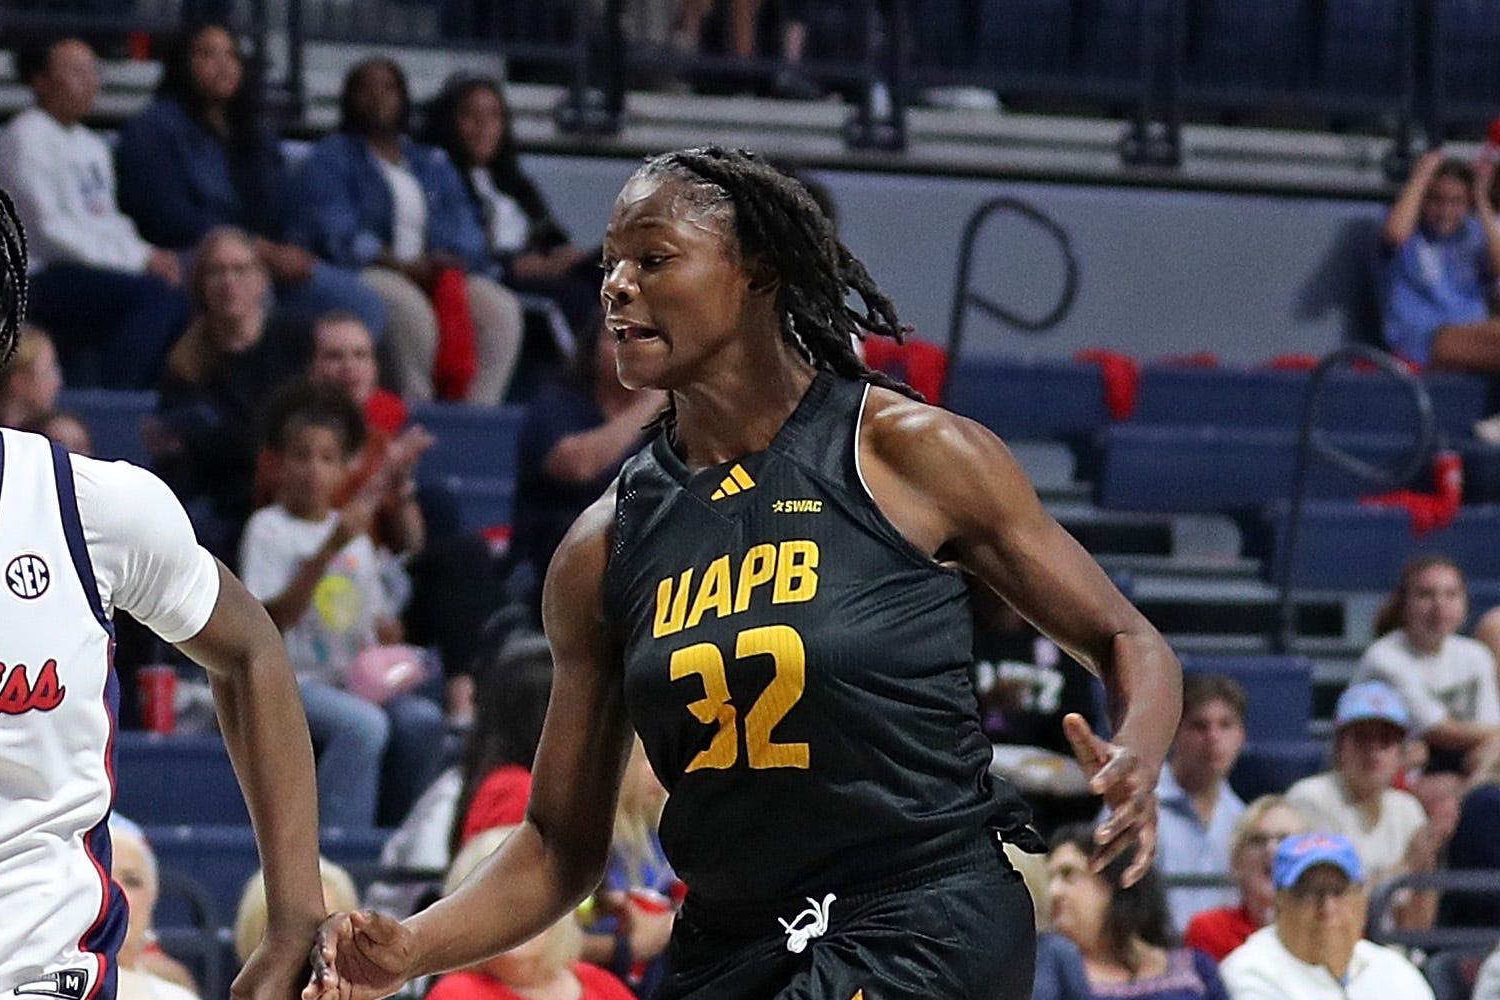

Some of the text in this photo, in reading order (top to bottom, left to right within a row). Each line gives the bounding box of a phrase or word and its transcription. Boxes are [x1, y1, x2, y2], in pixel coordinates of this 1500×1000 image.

[784, 500, 822, 513] SWAC
[7, 556, 49, 598] SEC
[652, 539, 819, 638] UAPB
[670, 624, 810, 773] 32
